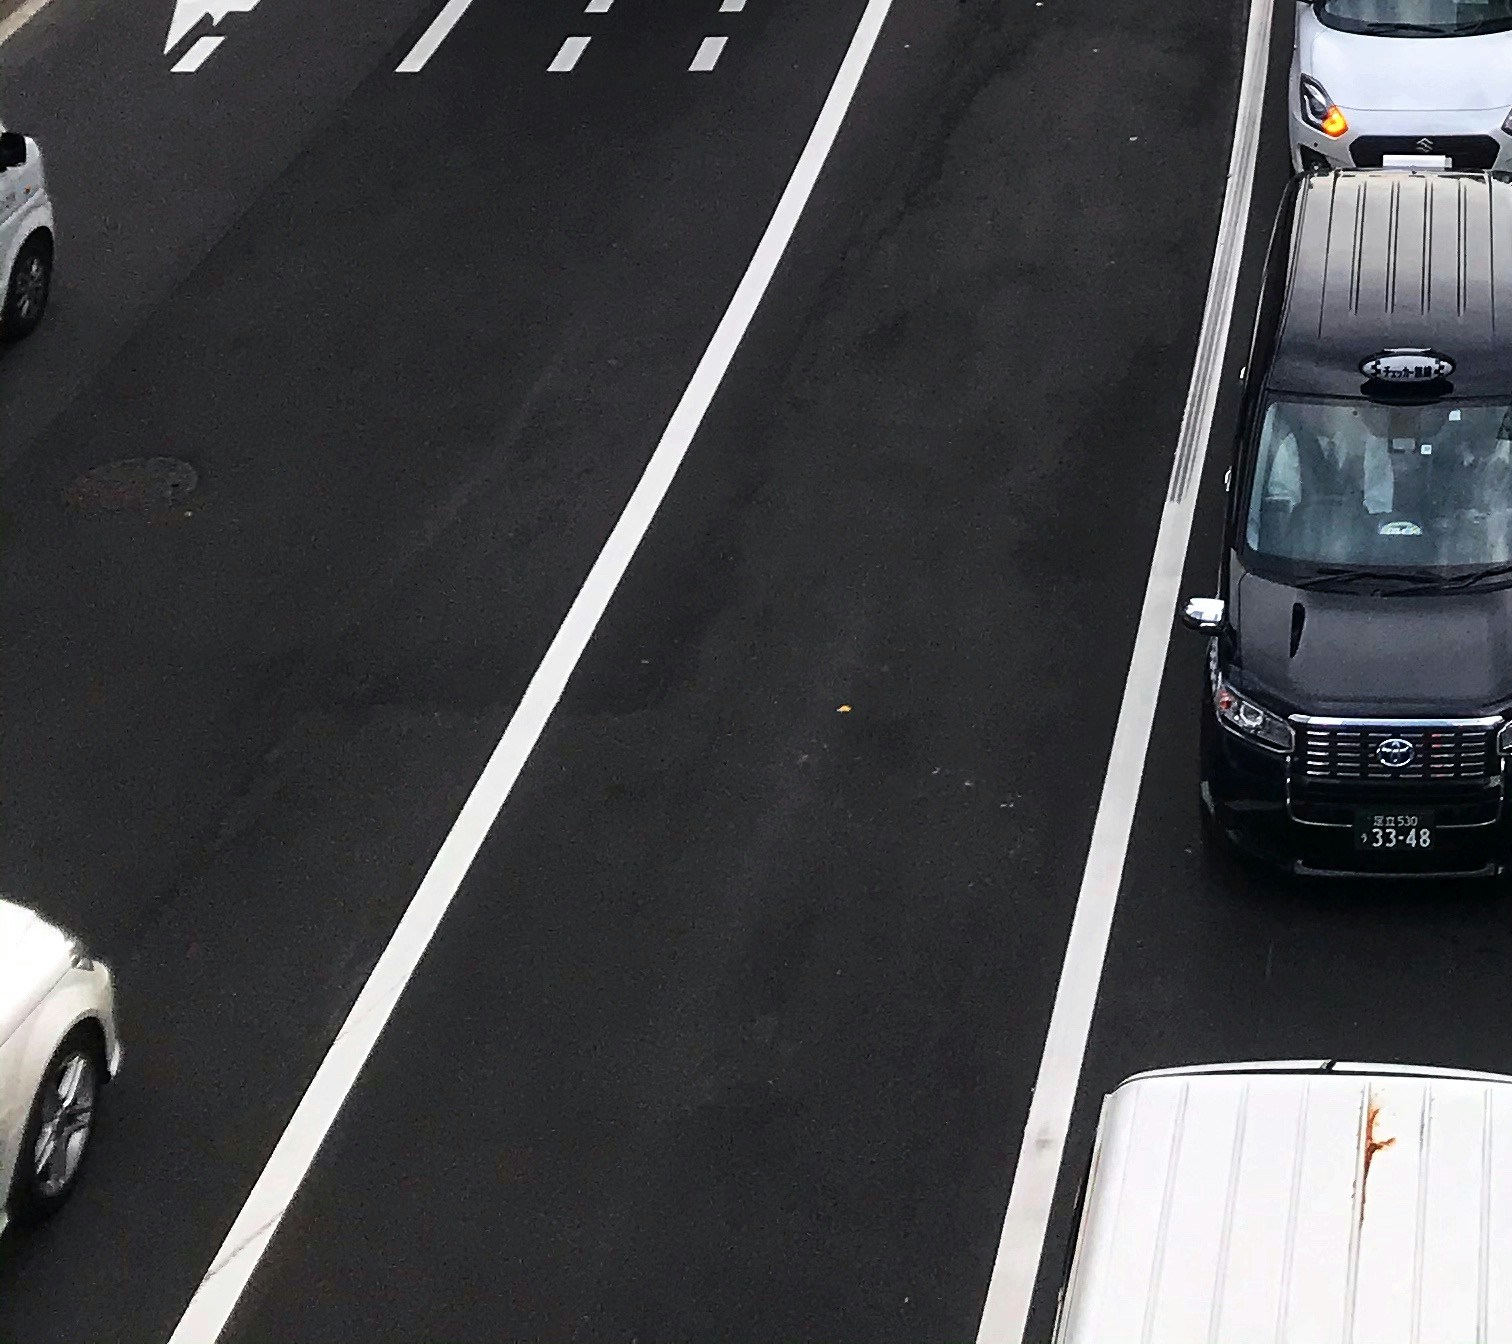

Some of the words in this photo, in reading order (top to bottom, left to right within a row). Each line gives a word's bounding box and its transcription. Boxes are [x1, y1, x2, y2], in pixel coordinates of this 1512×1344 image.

[1373, 815, 1395, 826] 足立
[1397, 815, 1418, 826] 530
[1372, 828, 1431, 847] 33-48
